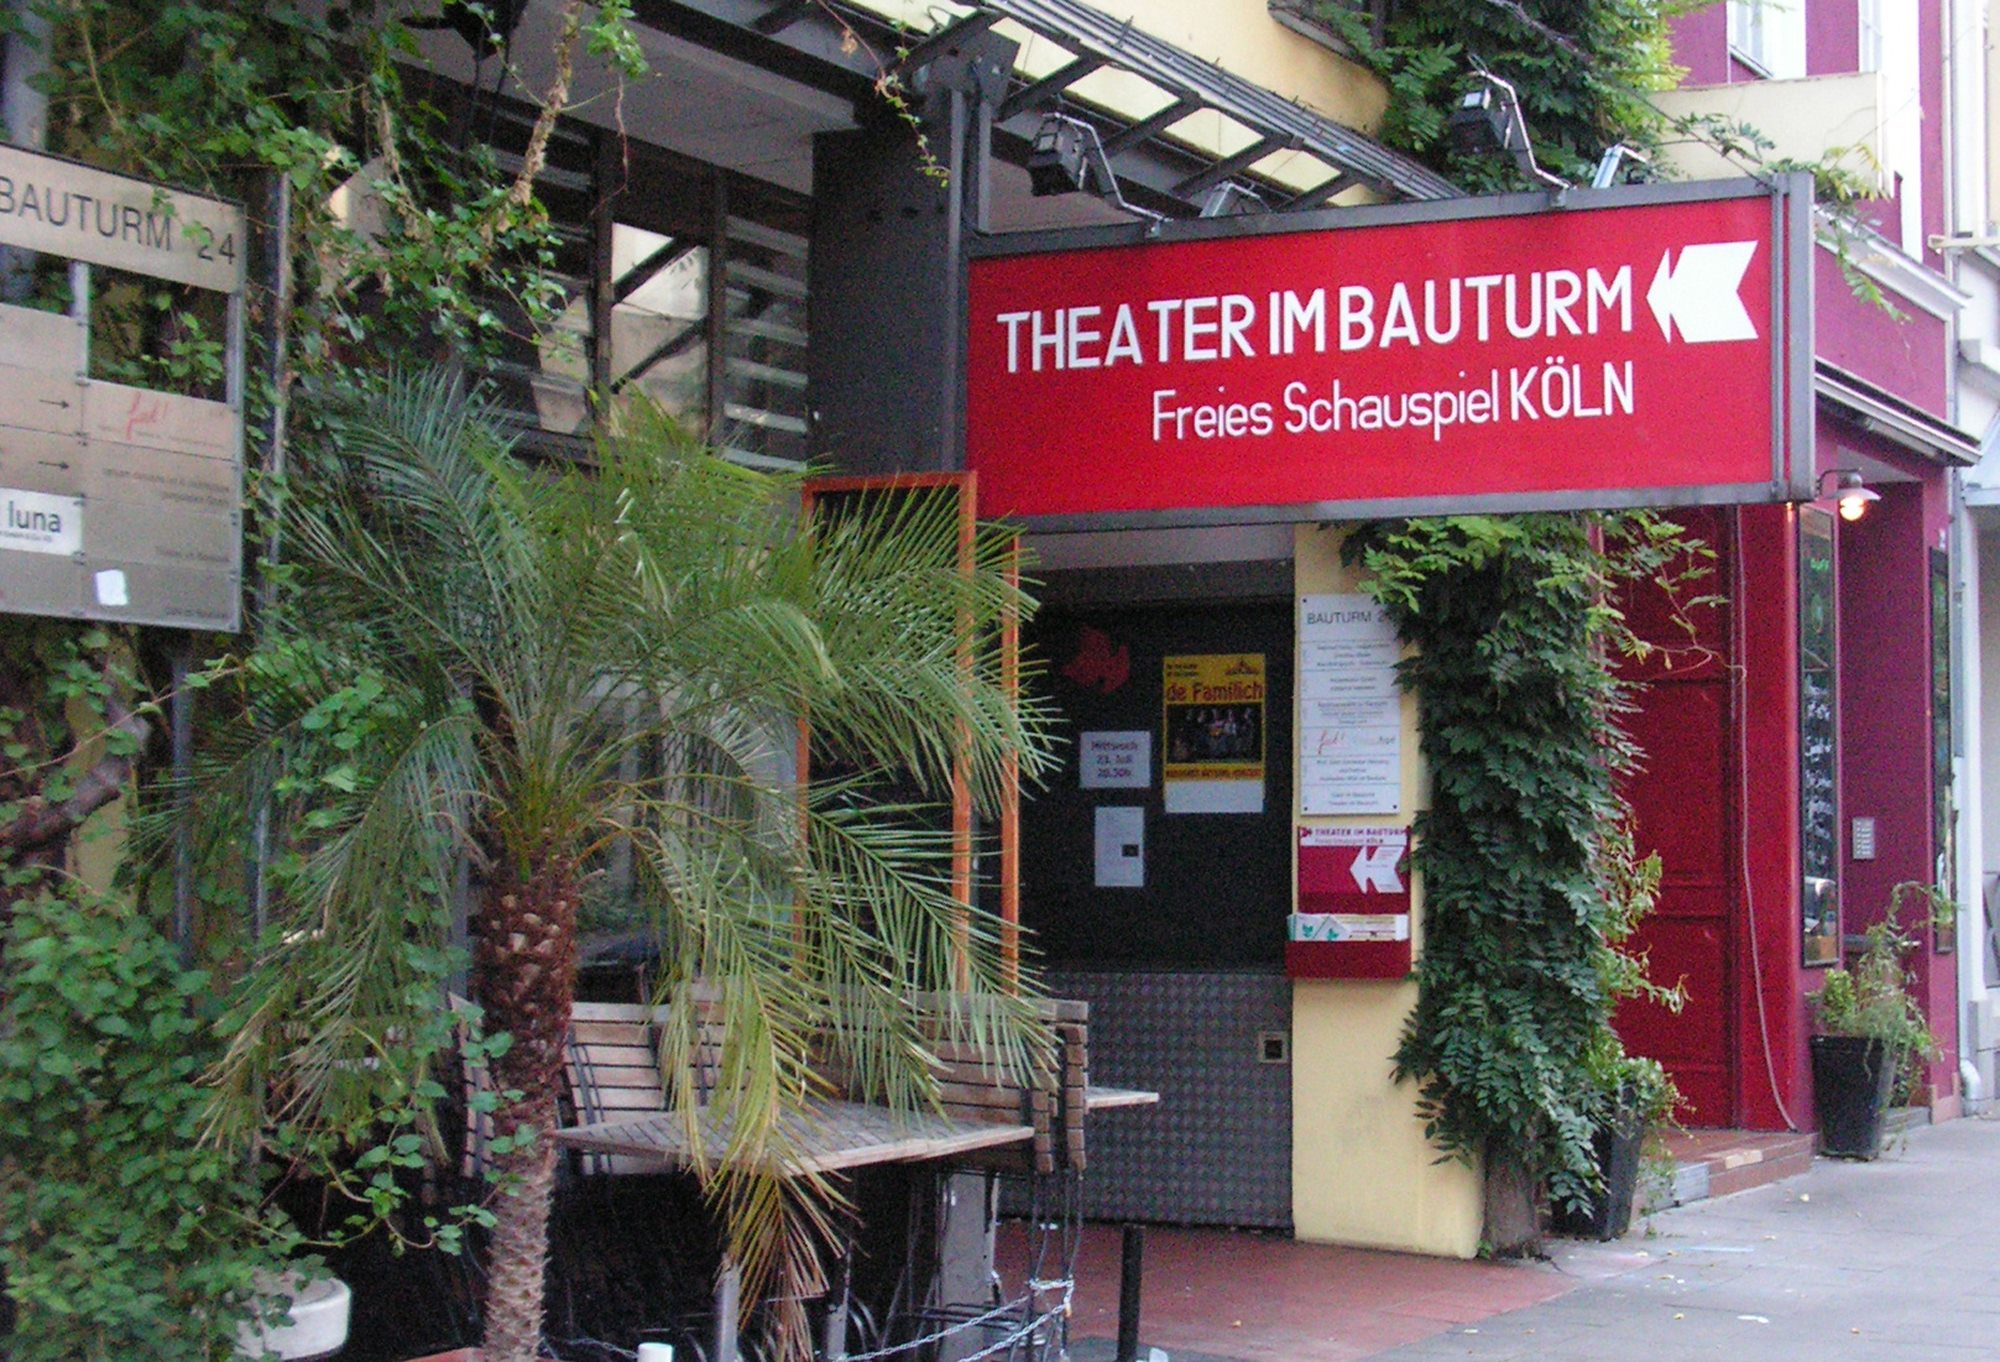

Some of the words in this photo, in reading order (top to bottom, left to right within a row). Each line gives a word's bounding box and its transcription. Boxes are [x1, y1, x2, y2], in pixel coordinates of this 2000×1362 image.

[0, 175, 172, 251] BAUTURM
[197, 226, 236, 265] 24
[997, 294, 1256, 374] THEATER
[1269, 288, 1327, 356] IM
[1339, 265, 1632, 352] BAUTURM
[1152, 387, 1274, 442] Freies
[1284, 369, 1500, 442] Schauspiel
[1510, 355, 1634, 422] KÖLN
[8, 500, 62, 533] luna
[1306, 611, 1373, 625] BAUTURM
